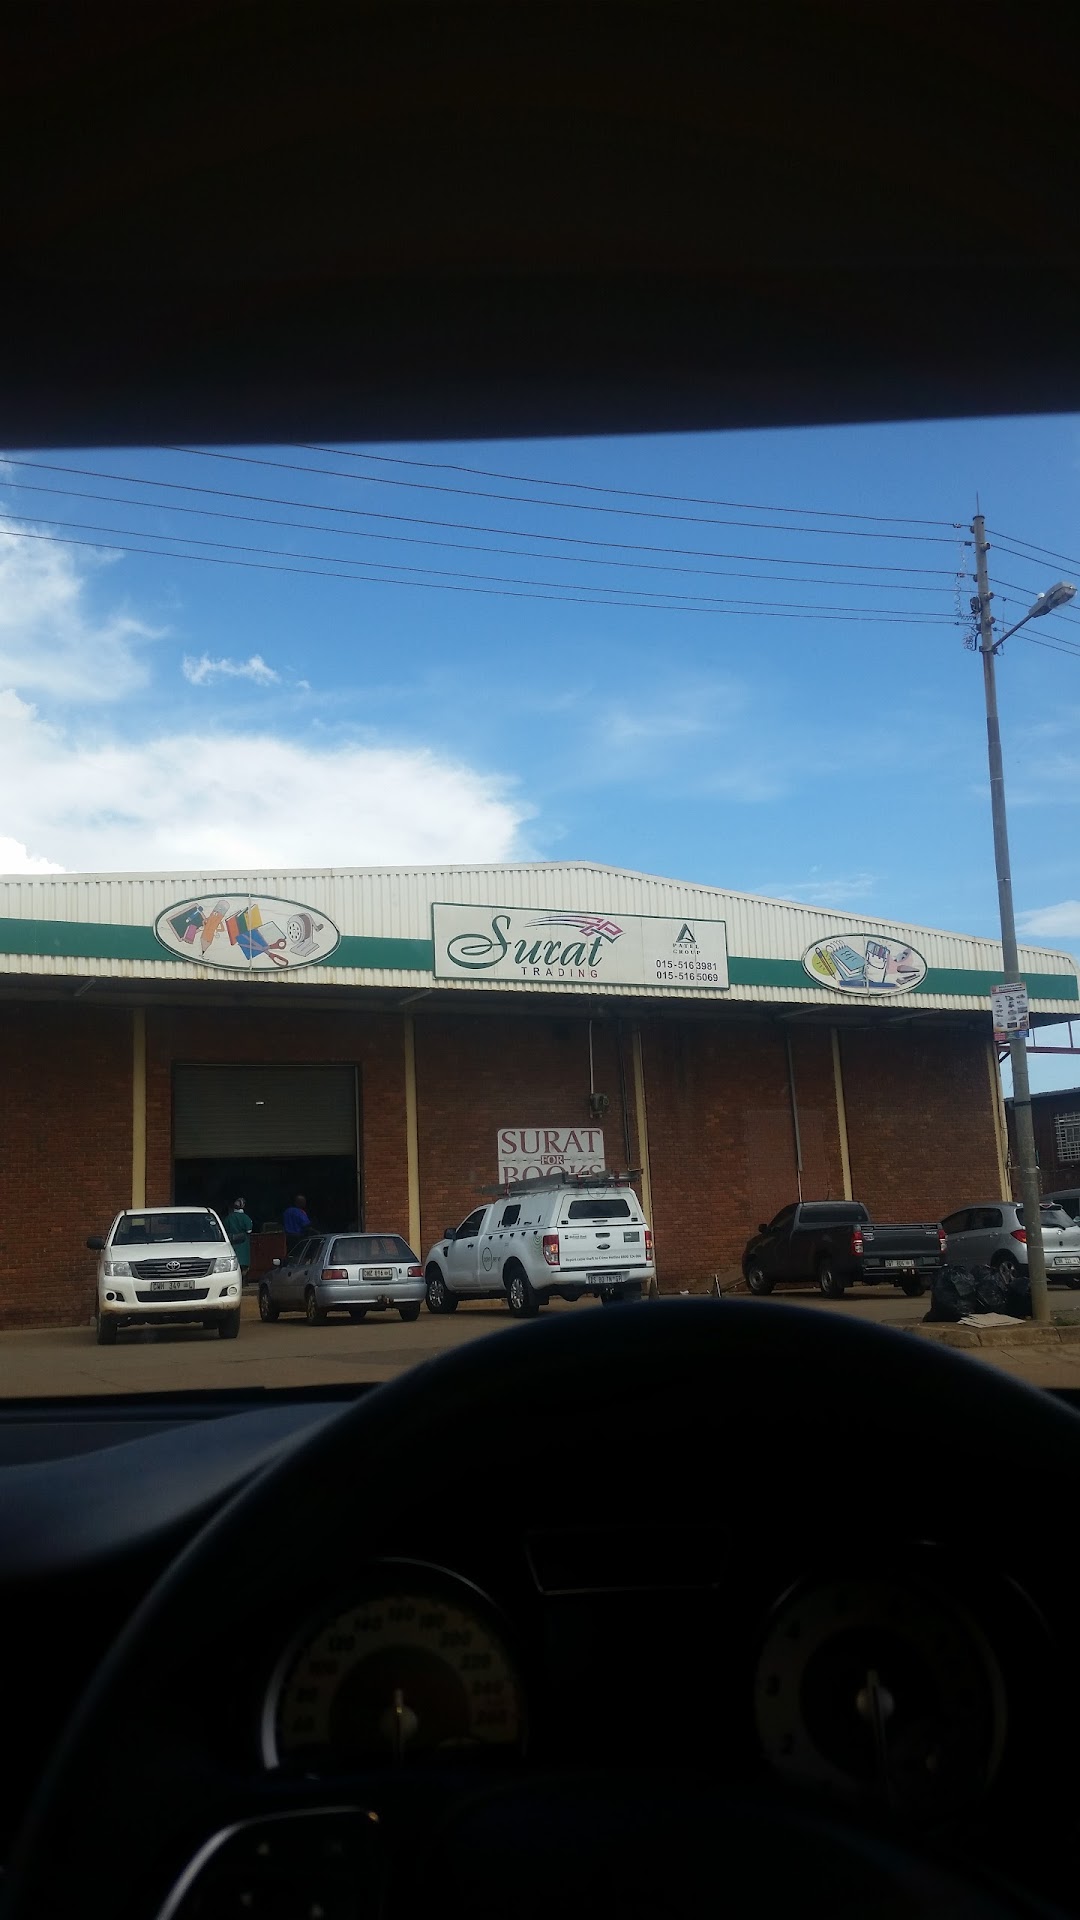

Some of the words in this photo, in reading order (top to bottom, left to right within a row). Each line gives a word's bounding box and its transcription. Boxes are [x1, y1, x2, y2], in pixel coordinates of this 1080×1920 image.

[447, 915, 603, 969] Surat
[521, 966, 598, 978] TRADING
[501, 1130, 600, 1154] SURAT
[541, 1155, 564, 1165] FOR
